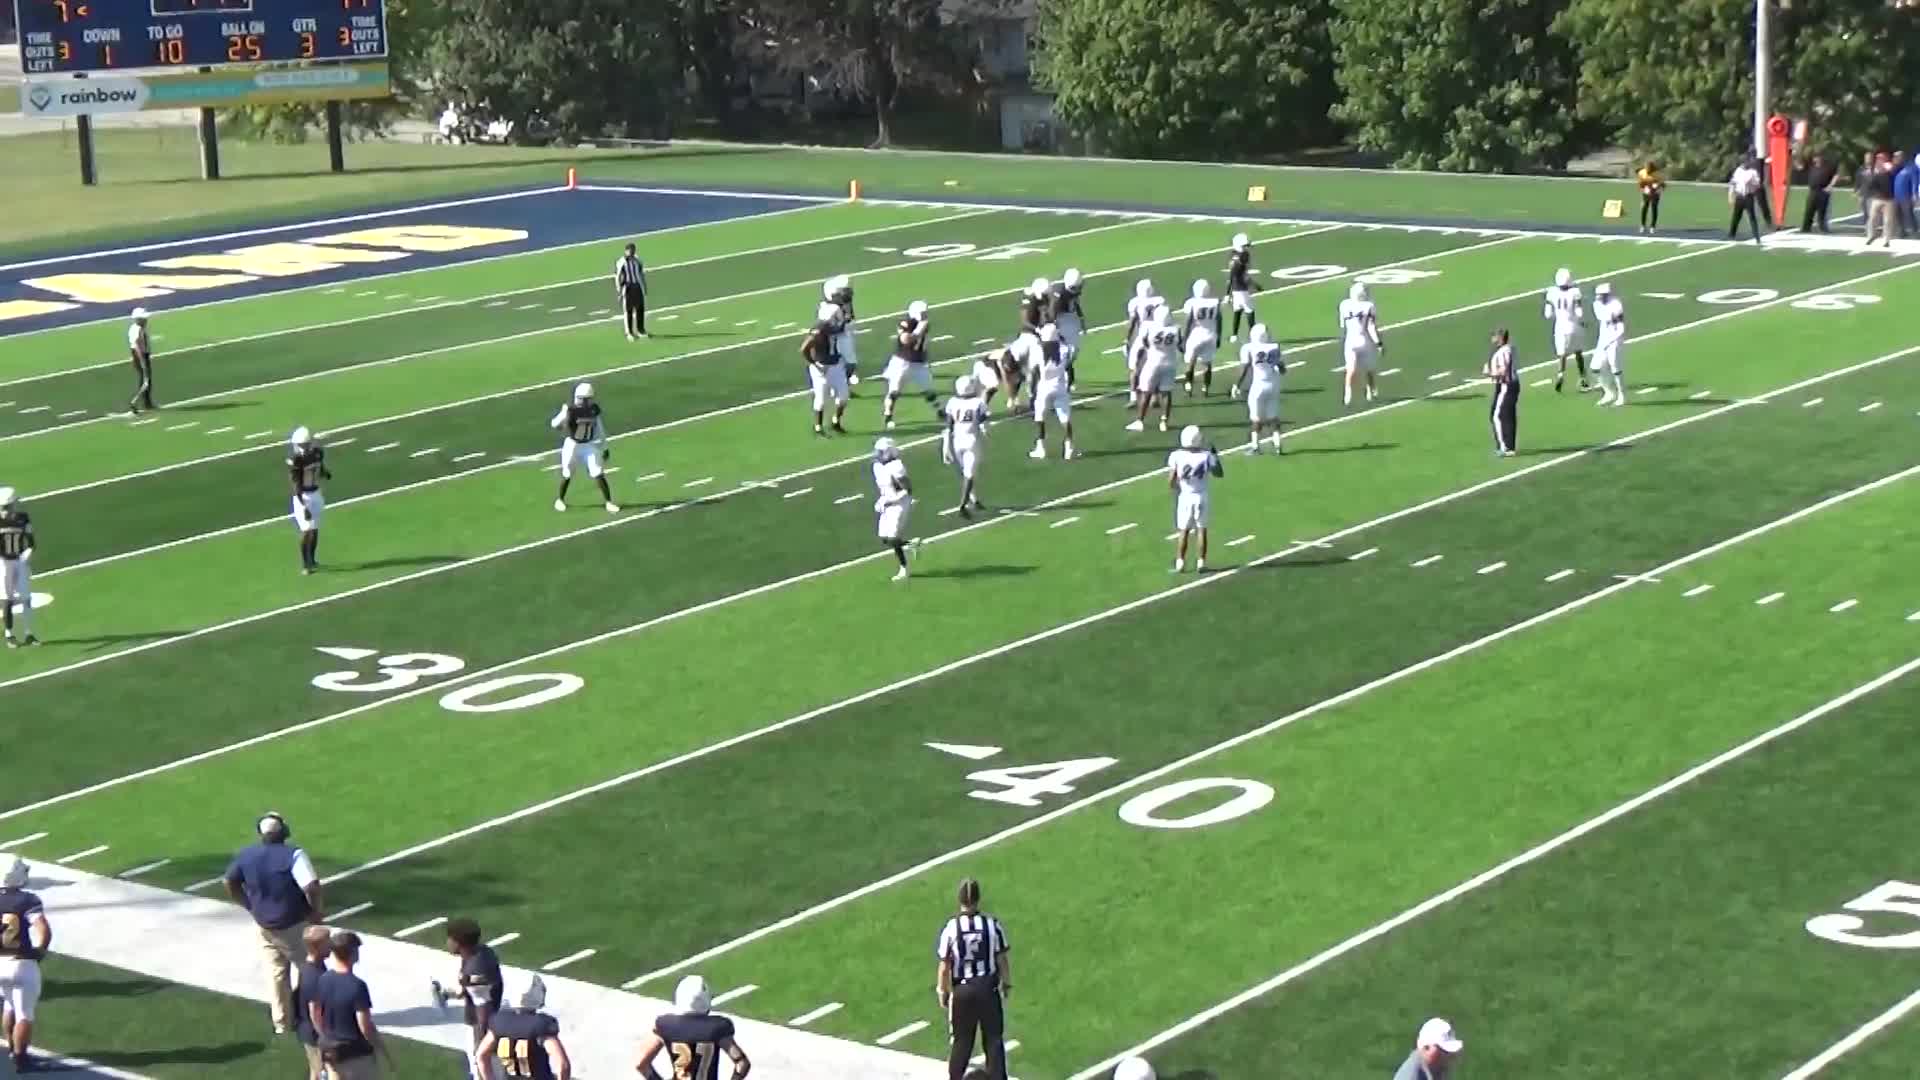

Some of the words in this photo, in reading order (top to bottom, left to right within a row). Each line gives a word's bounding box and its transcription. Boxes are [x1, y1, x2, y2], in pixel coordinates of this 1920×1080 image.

[83, 28, 120, 43] DOWN
[147, 26, 162, 40] TO
[165, 24, 184, 39] GO
[221, 22, 248, 35] BALL
[250, 20, 265, 34] ON
[338, 27, 349, 46] 3
[351, 29, 379, 41] OUTS
[25, 45, 54, 58] OUTS
[58, 43, 70, 60] 3
[160, 40, 183, 63] 10
[228, 36, 261, 60] 25
[301, 32, 314, 57] 3
[353, 42, 378, 54] LEFT
[105, 44, 111, 65] 1
[28, 59, 53, 71] LEFT
[61, 87, 137, 105] rainbow
[311, 652, 585, 713] 30
[965, 756, 1276, 829] 40
[962, 932, 983, 961] F
